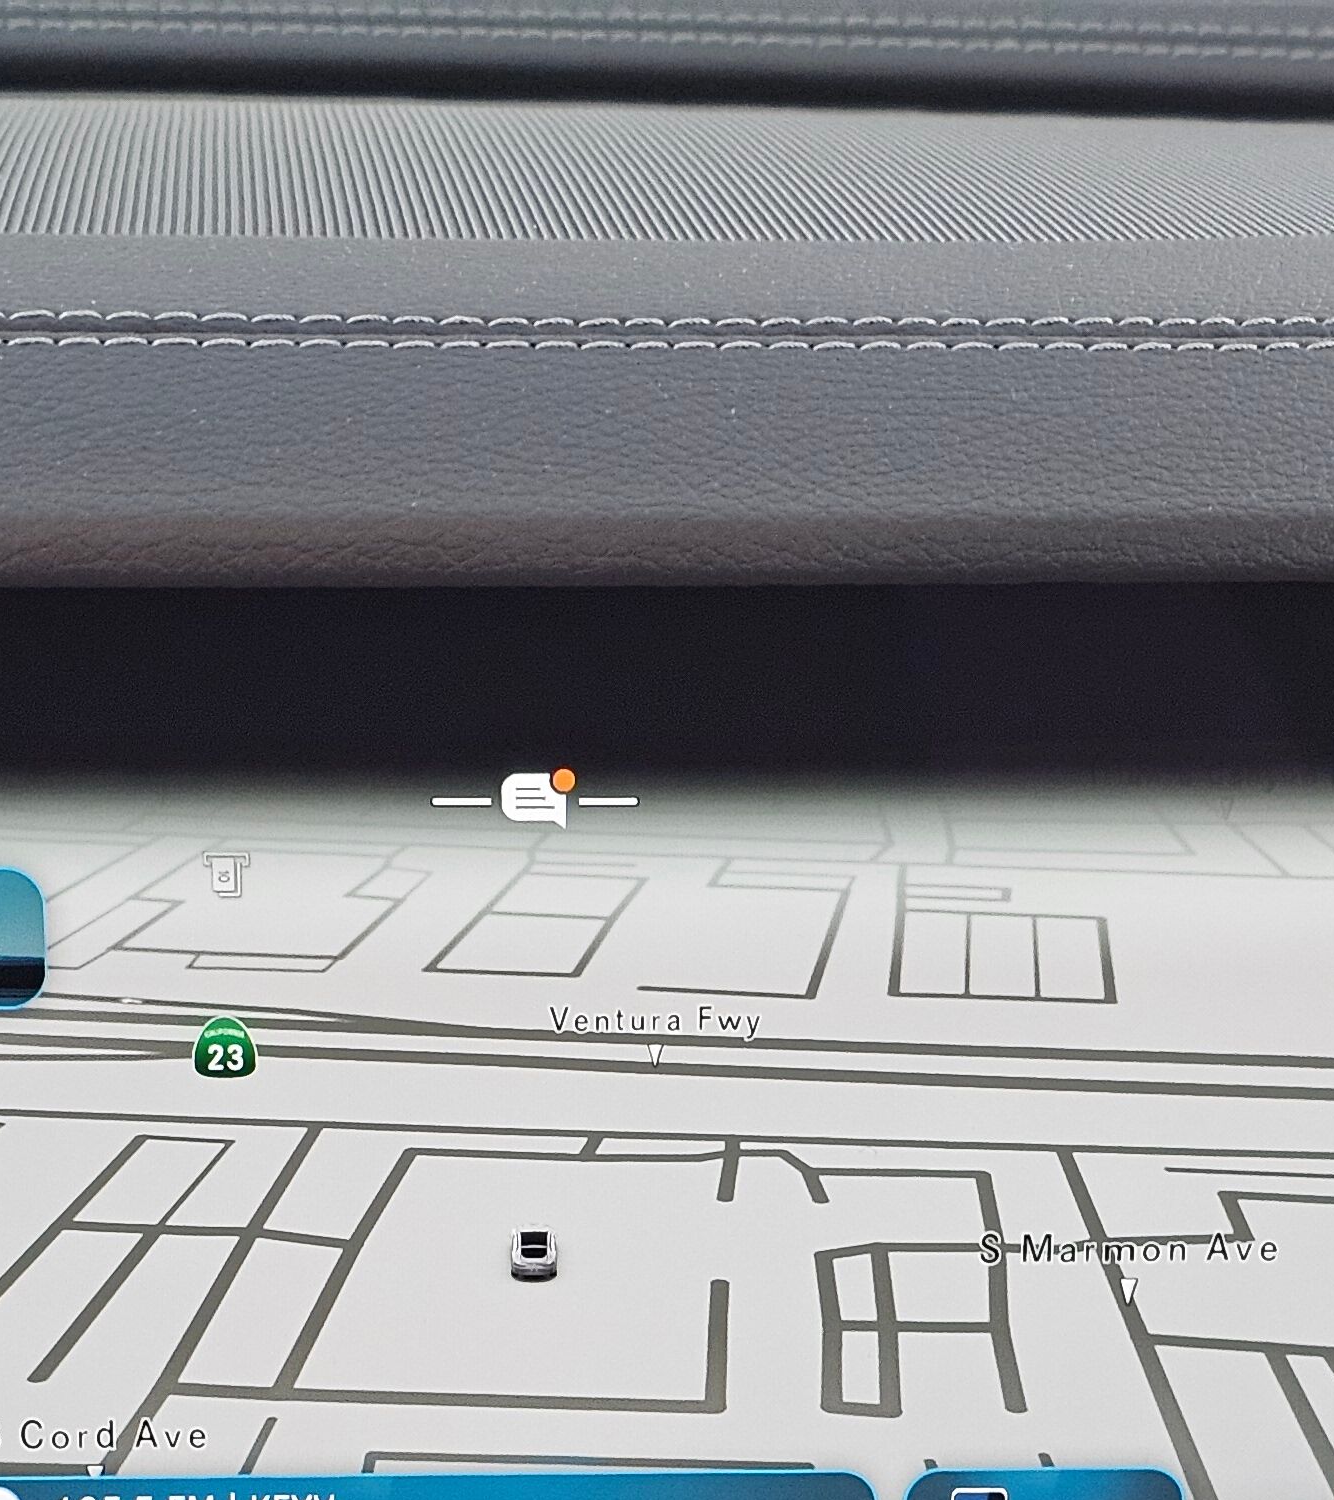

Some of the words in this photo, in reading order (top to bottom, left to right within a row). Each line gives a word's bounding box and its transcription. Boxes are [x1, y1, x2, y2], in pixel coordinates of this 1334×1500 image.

[550, 1007, 679, 1031] Ventura
[700, 1006, 759, 1039] Fwy
[207, 1044, 244, 1071] 23
[980, 1236, 1001, 1264] S
[1021, 1235, 1187, 1263] Marmon
[1207, 1234, 1278, 1262] Ave
[21, 1420, 113, 1449] Cord
[135, 1419, 206, 1449] Ave
